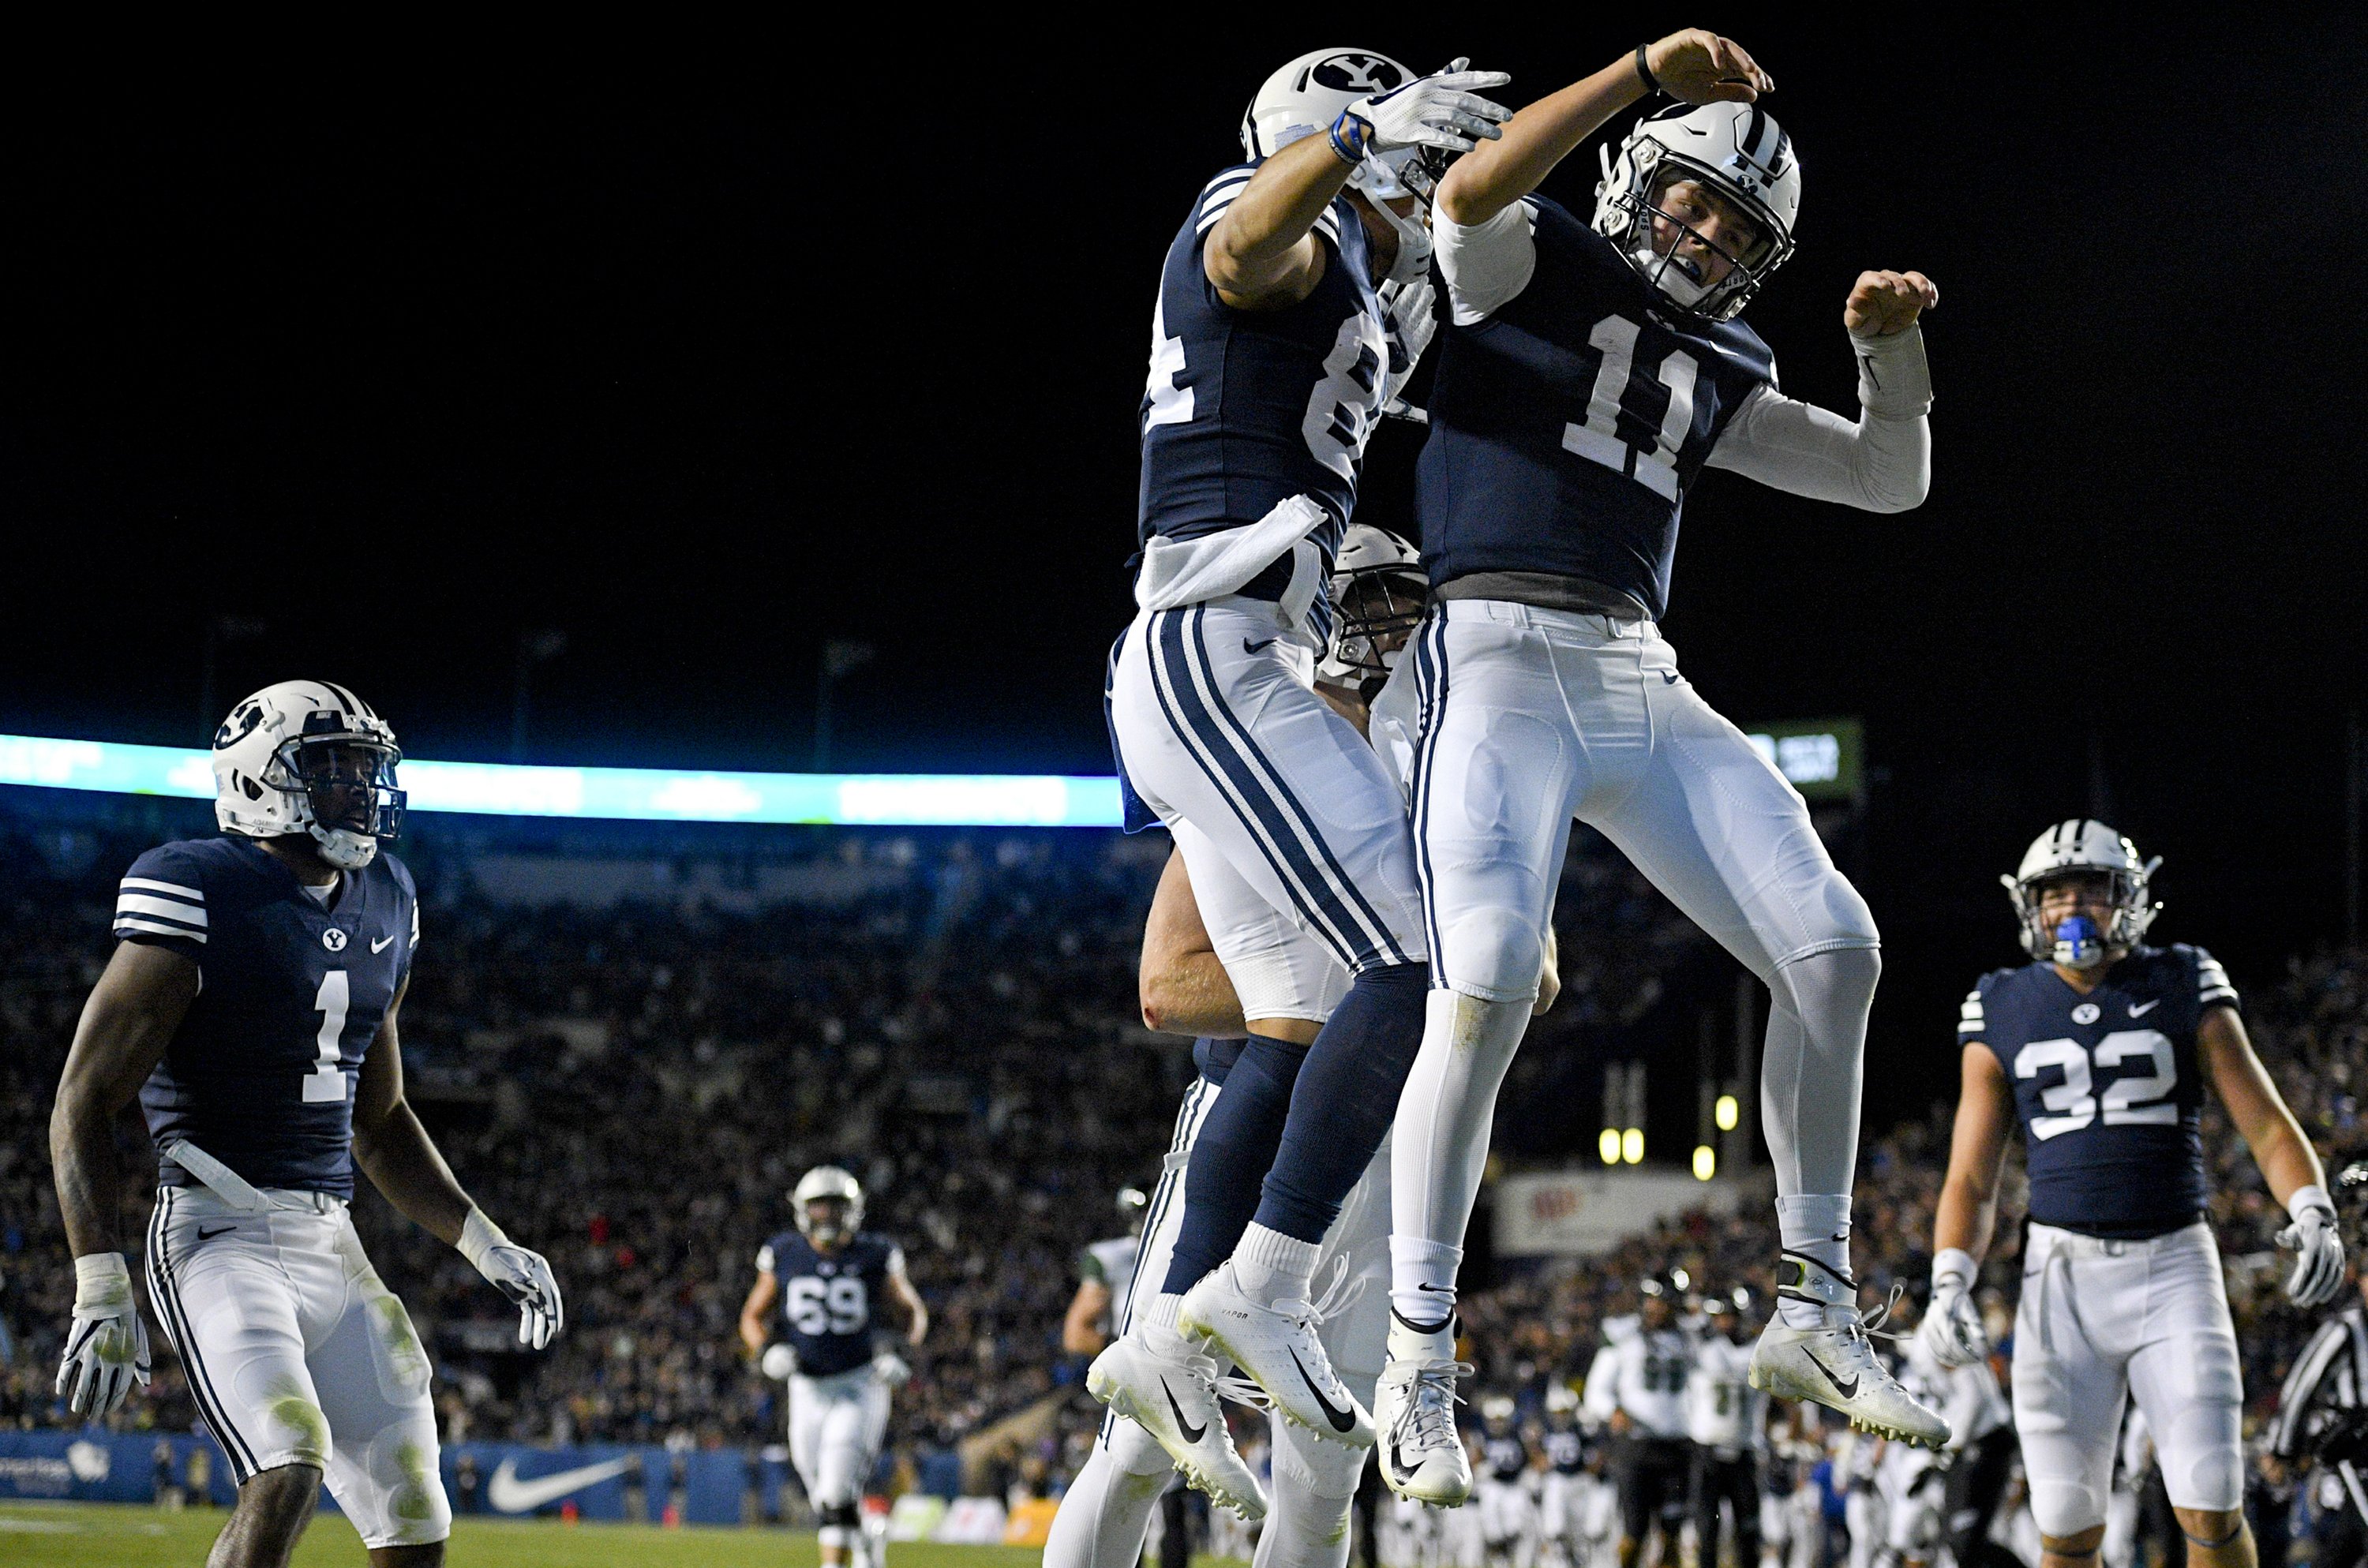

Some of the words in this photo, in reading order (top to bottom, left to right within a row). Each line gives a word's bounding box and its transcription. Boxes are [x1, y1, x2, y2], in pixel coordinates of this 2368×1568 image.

[1323, 55, 1385, 88] Y
[1561, 313, 1699, 503] 11
[327, 931, 343, 948] Y
[302, 970, 350, 1102] 1
[2014, 1028, 2179, 1141] 32
[786, 1276, 869, 1336] 69
[1221, 1308, 1249, 1319] VAPOR
